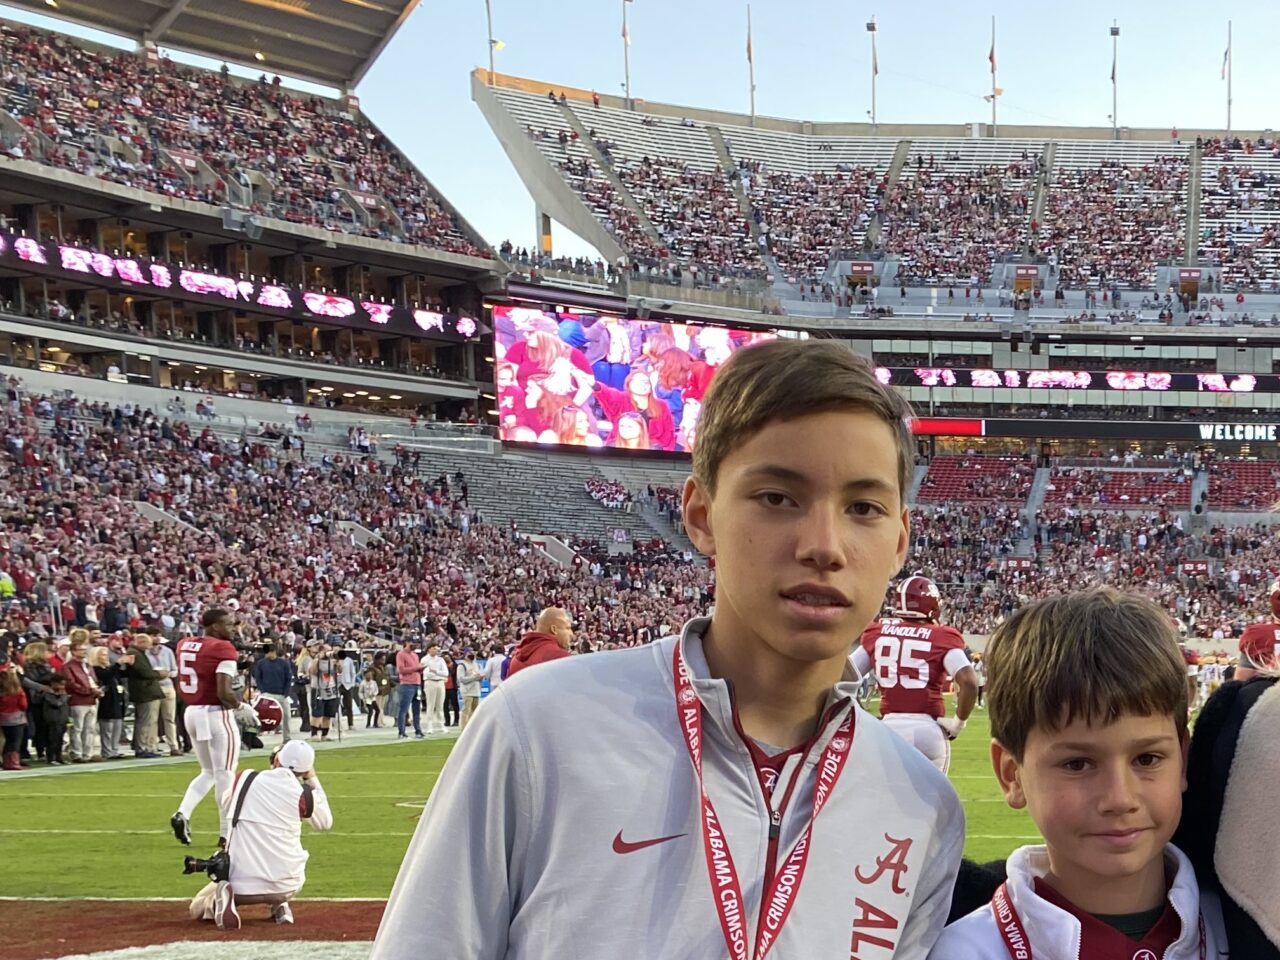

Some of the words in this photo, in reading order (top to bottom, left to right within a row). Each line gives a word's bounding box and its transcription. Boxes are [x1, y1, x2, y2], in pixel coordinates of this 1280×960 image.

[1199, 424, 1277, 441] WELCOME
[880, 625, 932, 640] RANDOLPH
[180, 652, 199, 694] 5
[874, 636, 932, 689] 85
[821, 750, 842, 784] TIDE
[704, 805, 733, 887] ALABAMA
[766, 864, 800, 931] CRIMSON
